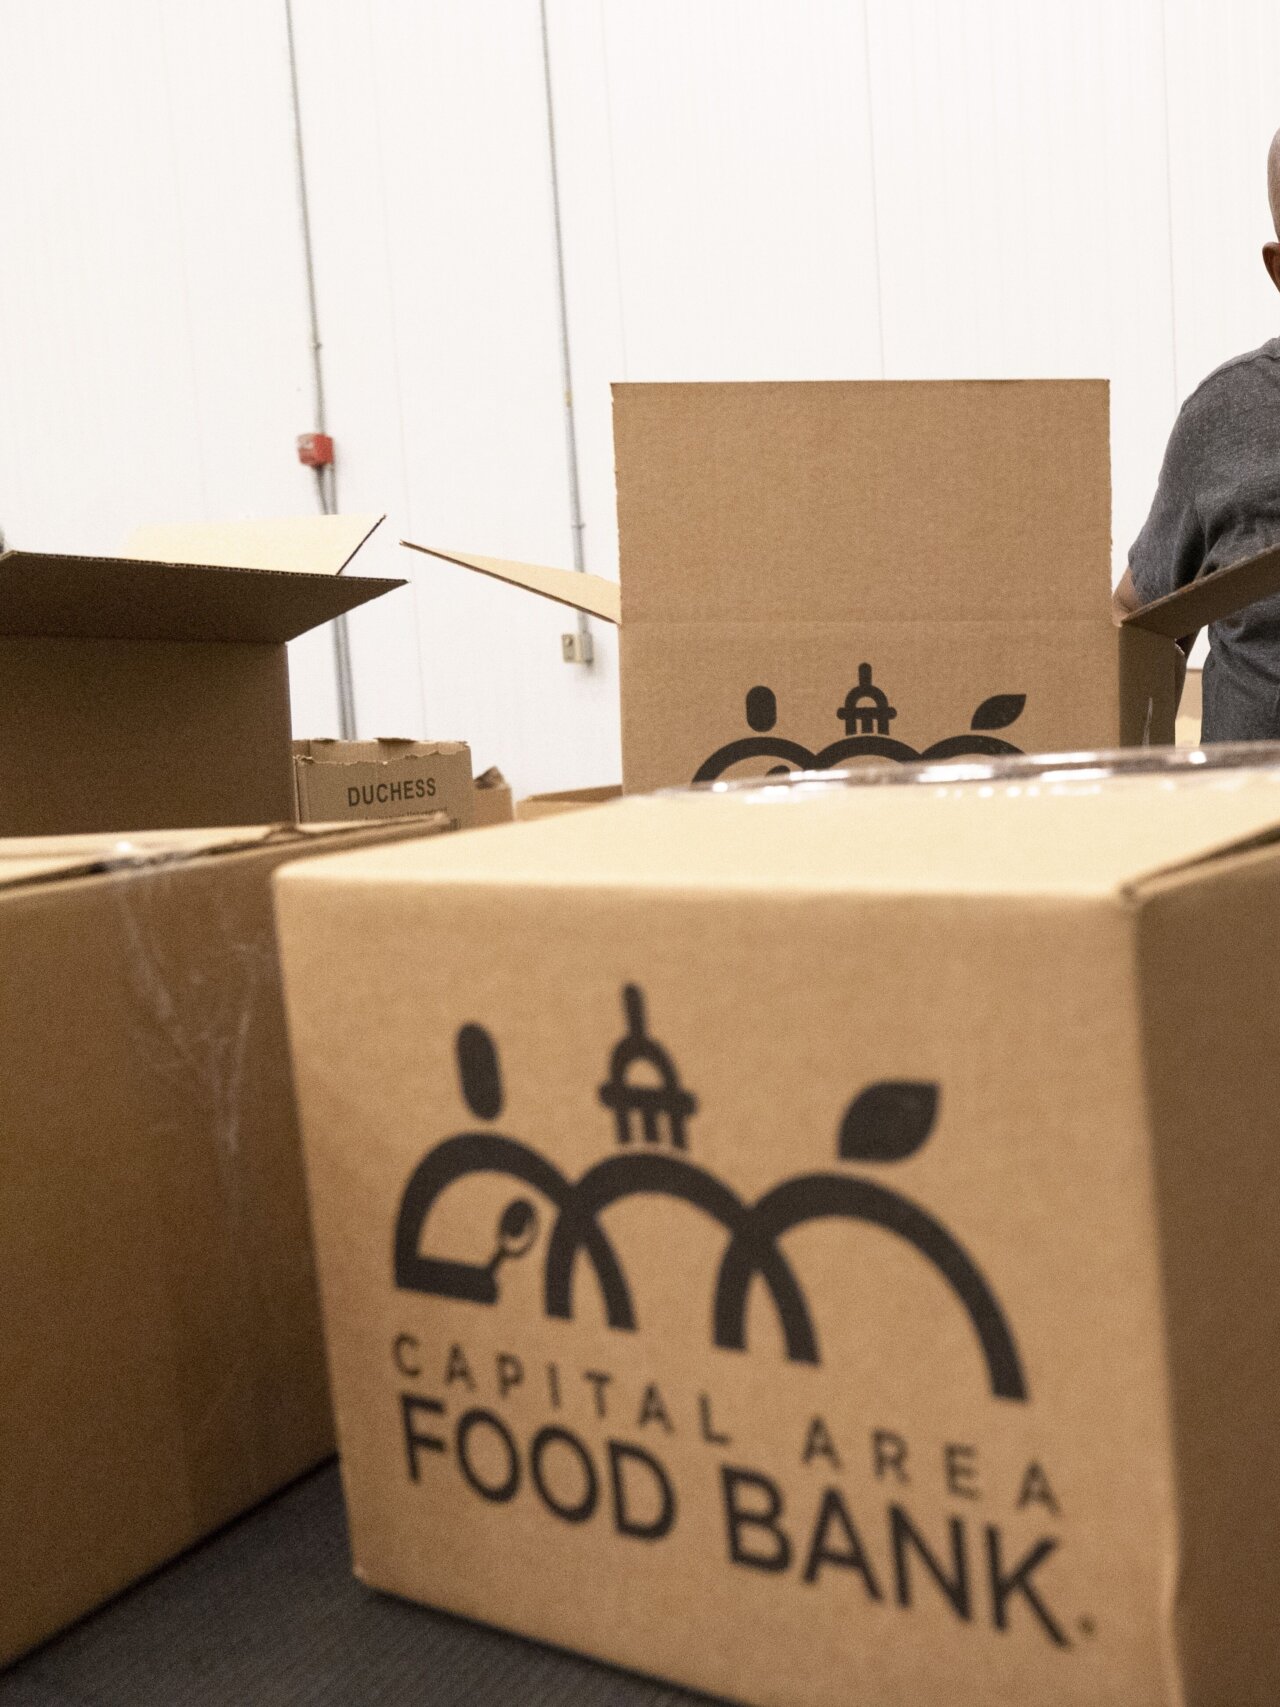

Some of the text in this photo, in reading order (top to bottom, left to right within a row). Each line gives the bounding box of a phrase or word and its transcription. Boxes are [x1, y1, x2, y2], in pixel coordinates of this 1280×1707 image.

[346, 777, 437, 808] DUCHESS
[391, 1332, 1062, 1514] CAPITAL AREA
[397, 1390, 678, 1543] FOOD
